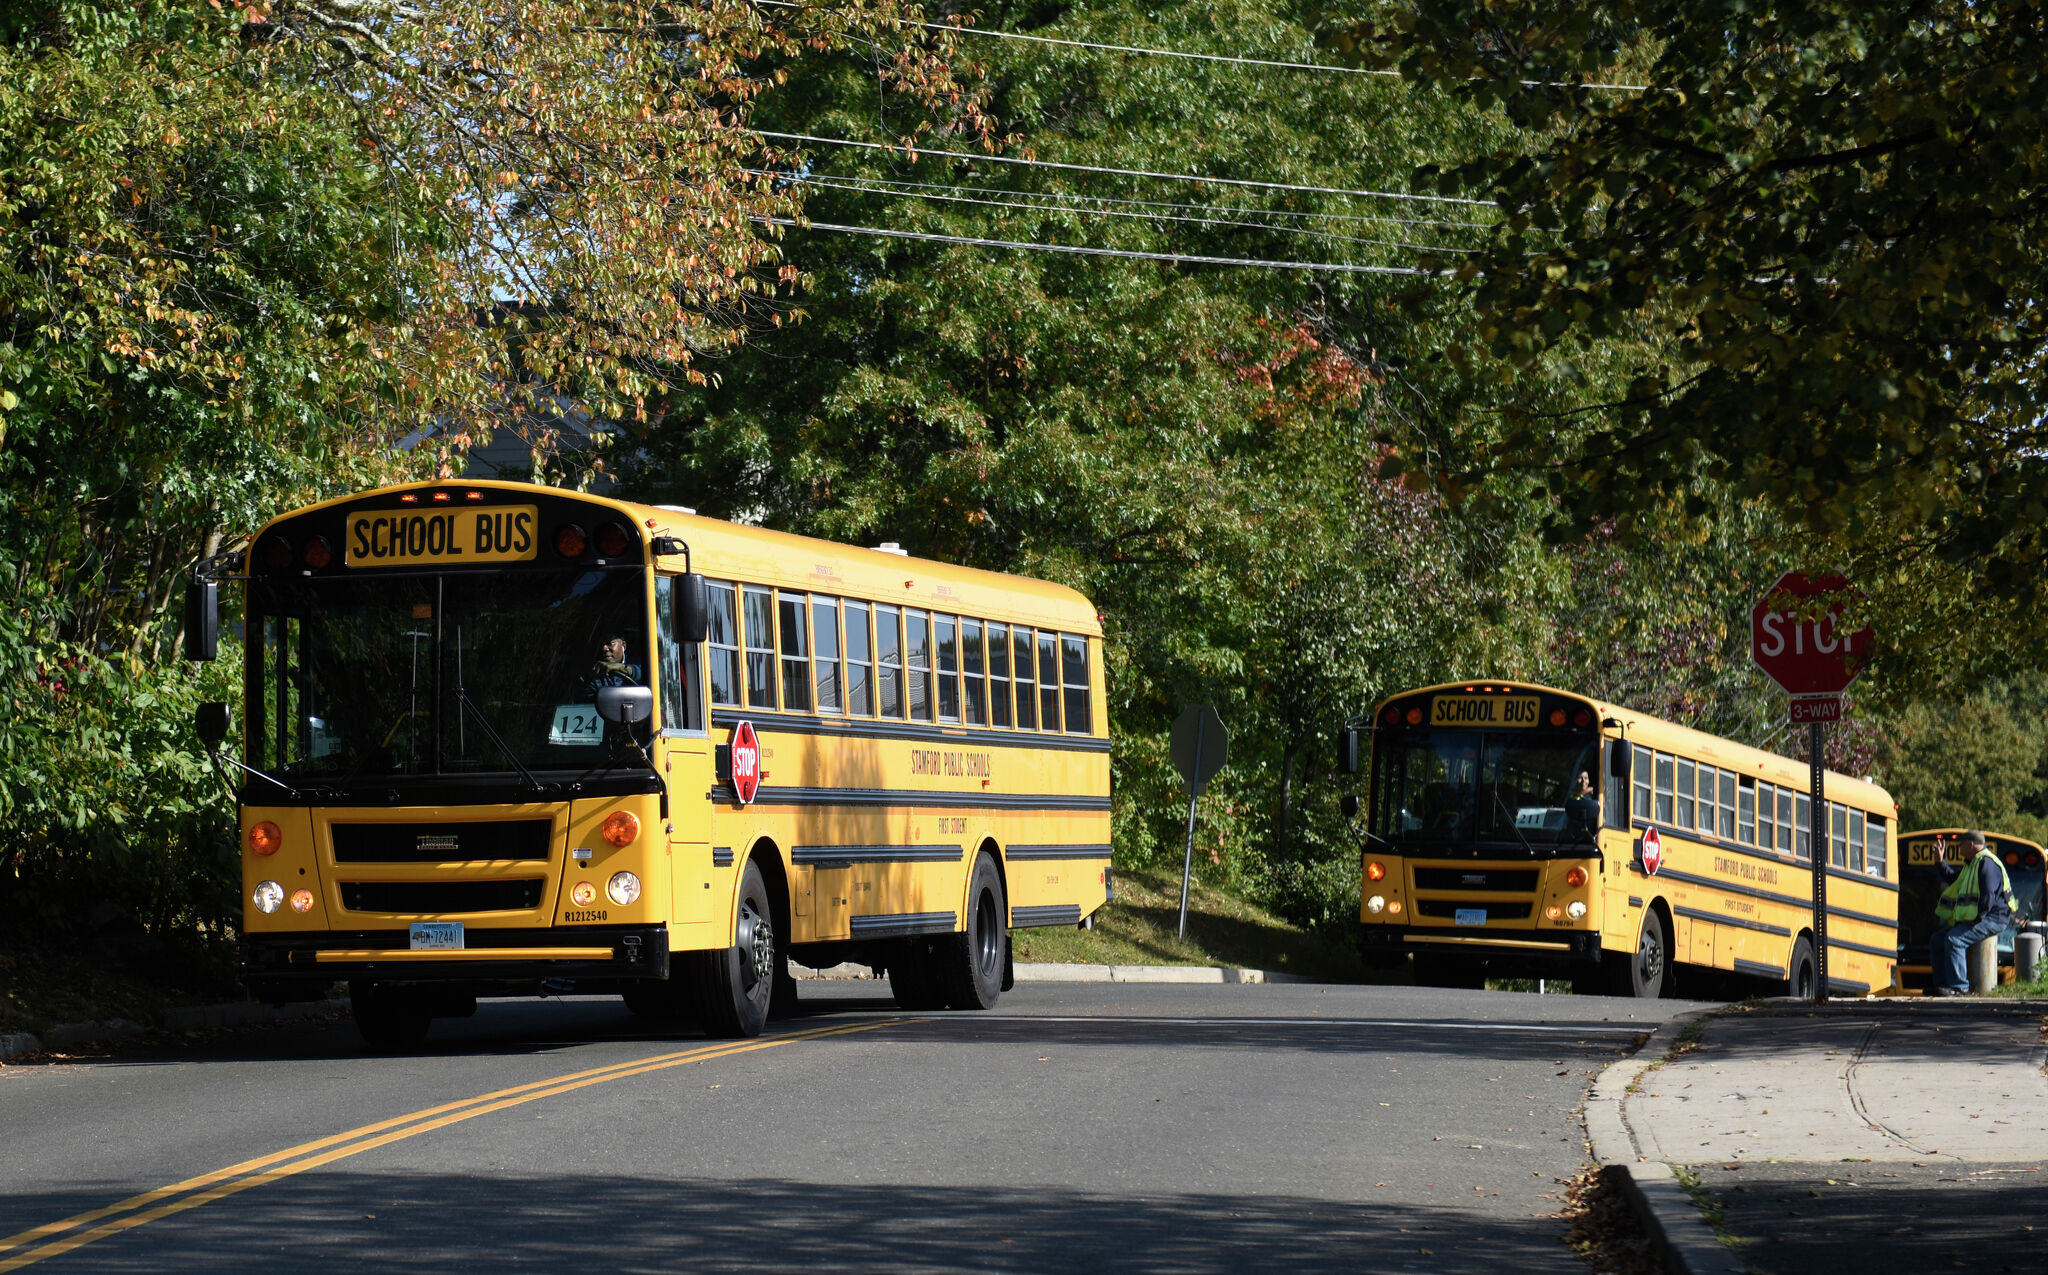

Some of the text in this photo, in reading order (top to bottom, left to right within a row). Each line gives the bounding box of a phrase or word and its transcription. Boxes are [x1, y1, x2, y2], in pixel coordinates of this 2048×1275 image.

[353, 512, 532, 559] SCHOOL BUS
[1436, 699, 1537, 722] SCHOOL BUS
[1793, 703, 1837, 719] 3-WAY
[560, 715, 598, 734] 124
[736, 747, 756, 777] STOP
[912, 749, 990, 778] STAMFORD PUBLIC SCHOOLS
[938, 817, 967, 834] FIRST STUDENT
[1645, 840, 1659, 860] STOP
[1912, 843, 1962, 862] SCHOL
[1714, 856, 1777, 885] STAMFORD PUBLIC SCHOOLS
[1725, 899, 1754, 914] FIRST STUDENT
[565, 911, 607, 922] R1212540
